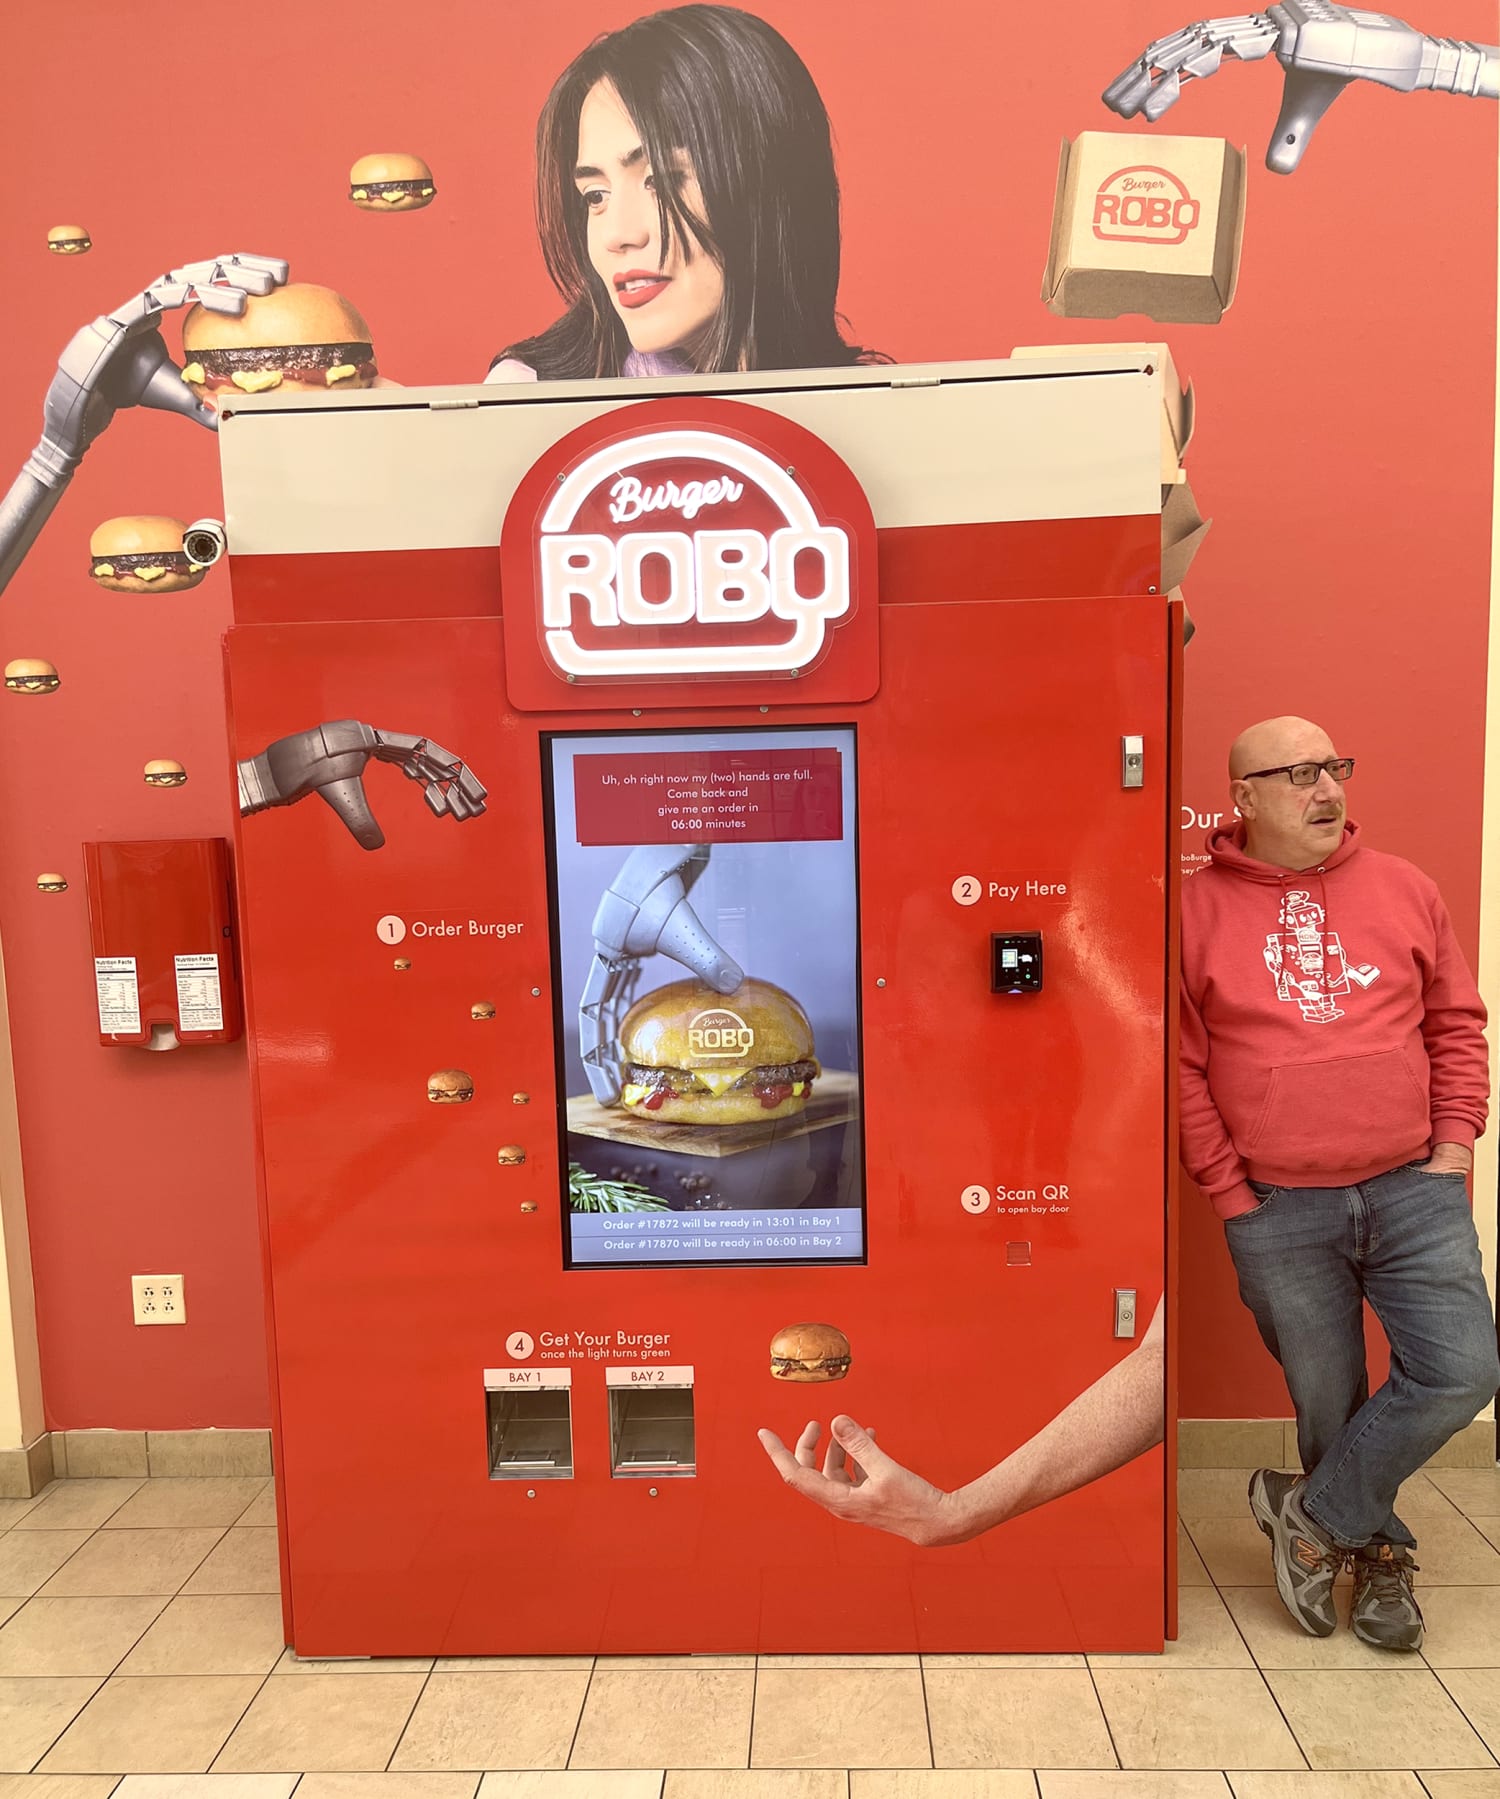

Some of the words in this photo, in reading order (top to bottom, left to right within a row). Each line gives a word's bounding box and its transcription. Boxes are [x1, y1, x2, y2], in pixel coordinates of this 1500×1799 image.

[1122, 177, 1165, 192] Burger
[1093, 194, 1200, 229] ROBO
[610, 475, 744, 523] Burger
[540, 526, 849, 627] ROBO
[602, 774, 620, 786] Uh,
[623, 774, 637, 784] oh
[640, 774, 664, 786] right
[667, 775, 689, 784] now
[692, 775, 707, 785] my
[710, 772, 735, 784] (two)
[739, 771, 770, 781] hands
[793, 769, 813, 780] full.
[667, 788, 698, 799] Come
[701, 788, 726, 798] back
[728, 787, 748, 797] and
[658, 804, 679, 817] give
[682, 806, 698, 814] me
[701, 805, 715, 813] an
[718, 802, 745, 813] order
[749, 802, 759, 812] in
[671, 819, 703, 830] 06:00
[705, 818, 746, 829] minutes
[961, 882, 972, 898] 2
[989, 882, 1020, 902] Pay
[1026, 880, 1067, 896] Here
[411, 920, 463, 937] Order
[469, 919, 524, 939] Burger
[688, 1028, 754, 1048] ROBO
[971, 1192, 981, 1207] 3
[996, 1185, 1036, 1200] Scan
[1042, 1184, 1069, 1200] QR
[997, 1206, 1006, 1214] to
[1008, 1206, 1029, 1215] open
[1031, 1204, 1047, 1215] bay
[1049, 1203, 1069, 1213] door
[603, 1220, 635, 1230] Order
[638, 1219, 679, 1229] #17872
[682, 1218, 701, 1228] will
[704, 1219, 717, 1228] be
[720, 1218, 750, 1229] ready
[752, 1217, 763, 1227] in
[767, 1217, 795, 1226] 13:01
[800, 1216, 809, 1226] in
[812, 1216, 832, 1228] Bay
[603, 1240, 635, 1250] Order
[638, 1239, 680, 1249] #17870
[682, 1238, 701, 1248] will
[704, 1238, 717, 1248] be
[720, 1238, 751, 1249] ready
[753, 1237, 763, 1247] in
[766, 1236, 797, 1247] 06:00
[800, 1236, 810, 1246] in
[813, 1236, 832, 1247] Bay
[835, 1236, 842, 1246] 2
[514, 1337, 524, 1352] 4
[540, 1331, 570, 1347] Get
[574, 1331, 611, 1346] Your
[617, 1330, 671, 1349] Burger
[540, 1351, 566, 1359] once
[568, 1348, 585, 1358] the
[587, 1347, 610, 1360] light
[612, 1349, 638, 1357] turns
[640, 1349, 671, 1360] green
[509, 1372, 531, 1382] BAY
[631, 1371, 653, 1382] BAY
[657, 1370, 665, 1381] 2
